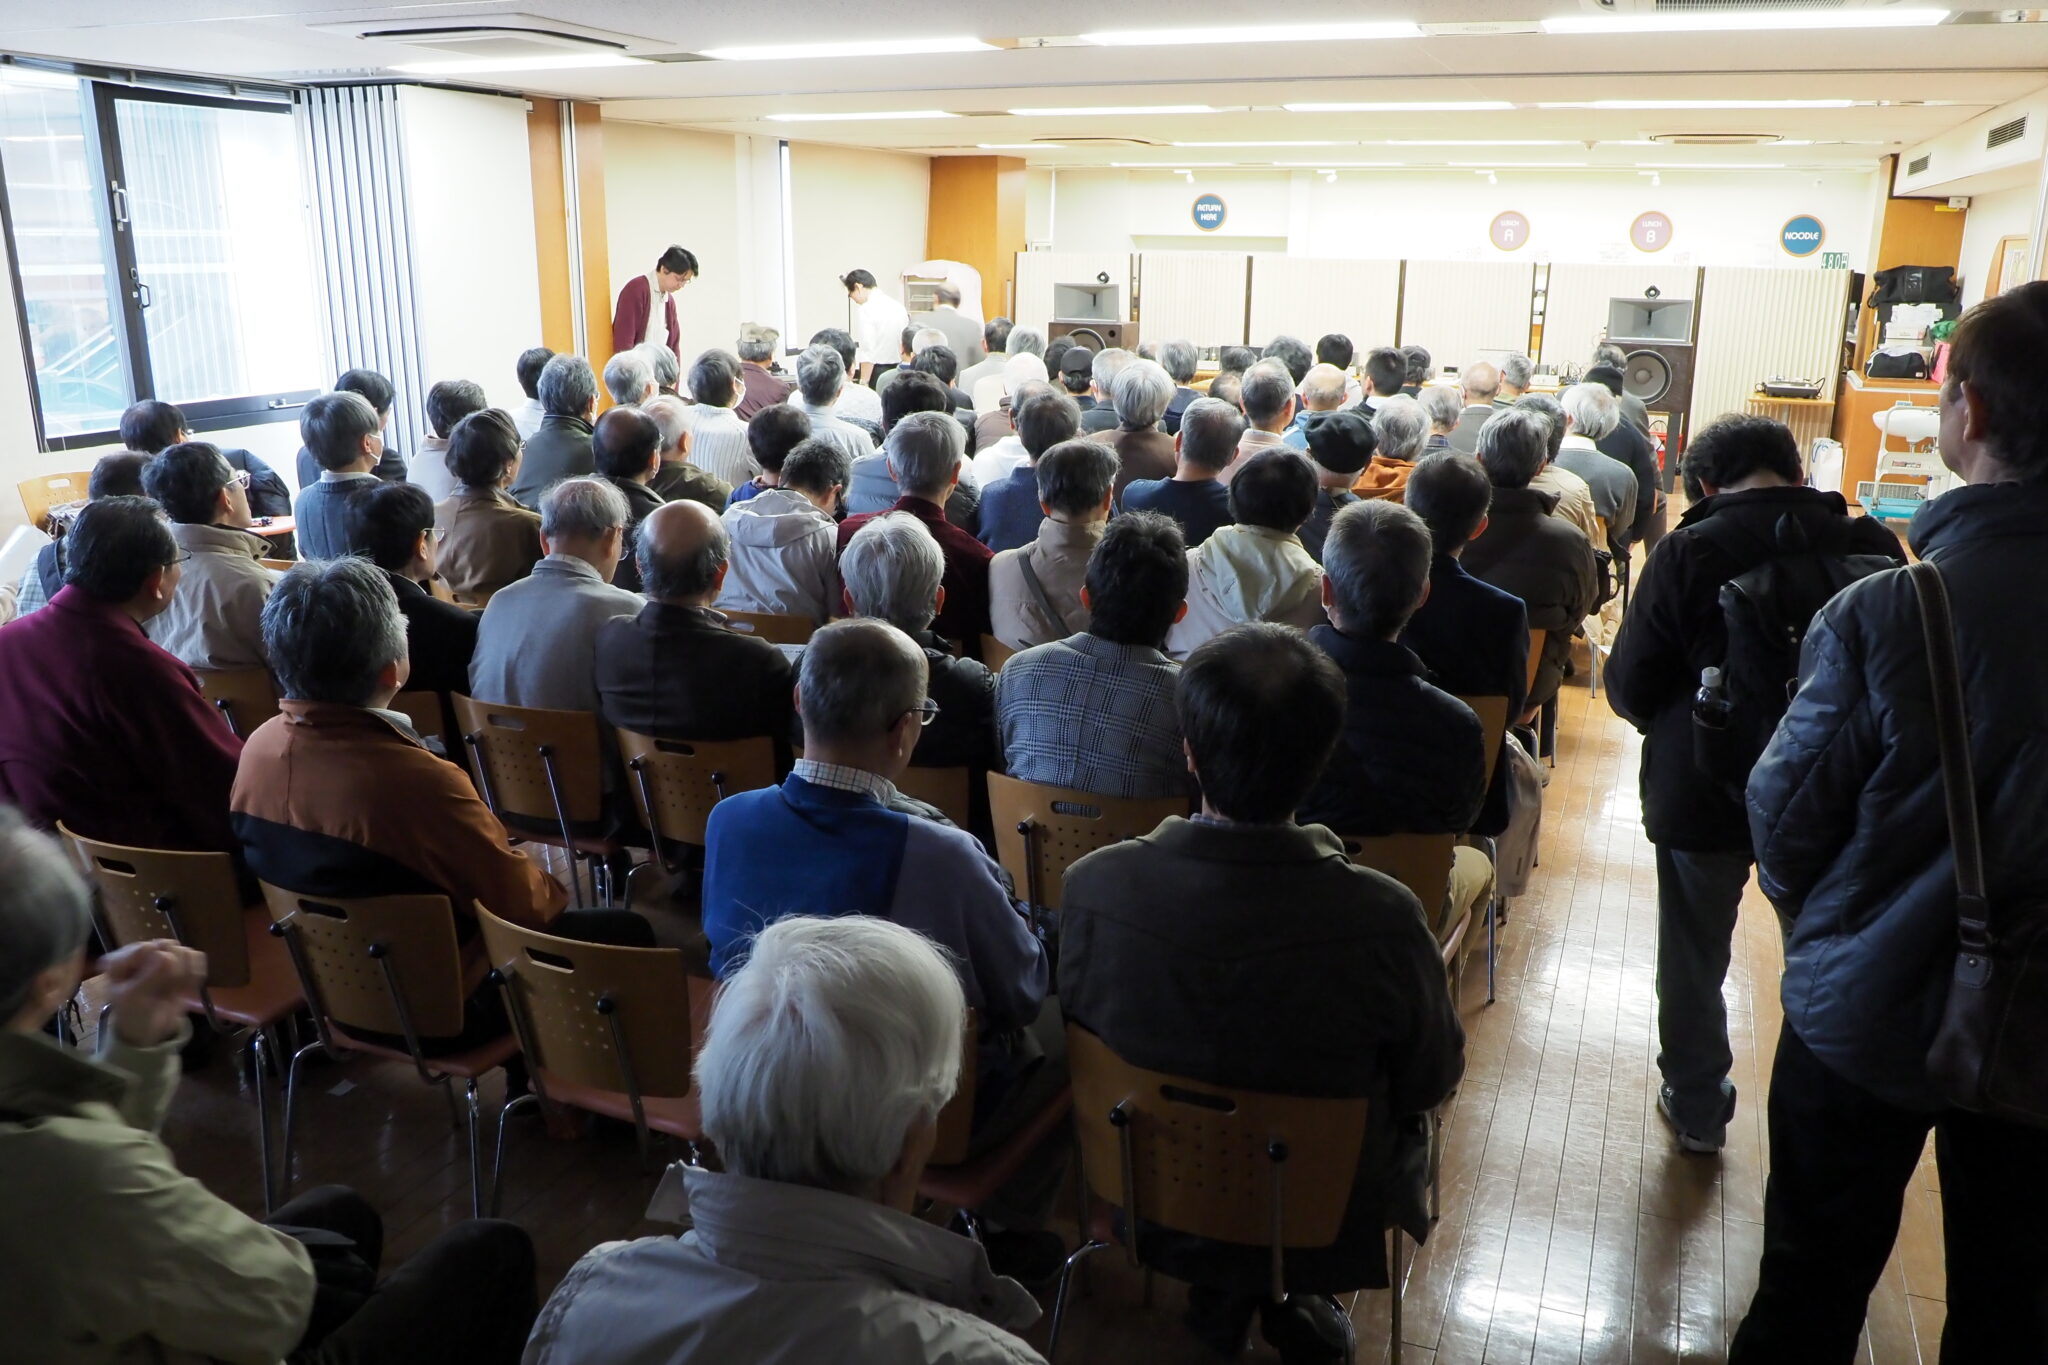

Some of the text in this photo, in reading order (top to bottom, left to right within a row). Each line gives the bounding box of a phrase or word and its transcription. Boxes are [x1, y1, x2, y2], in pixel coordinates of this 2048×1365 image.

[1504, 228, 1513, 241] A
[1646, 230, 1656, 242] B
[1784, 232, 1820, 240] NOODLE
